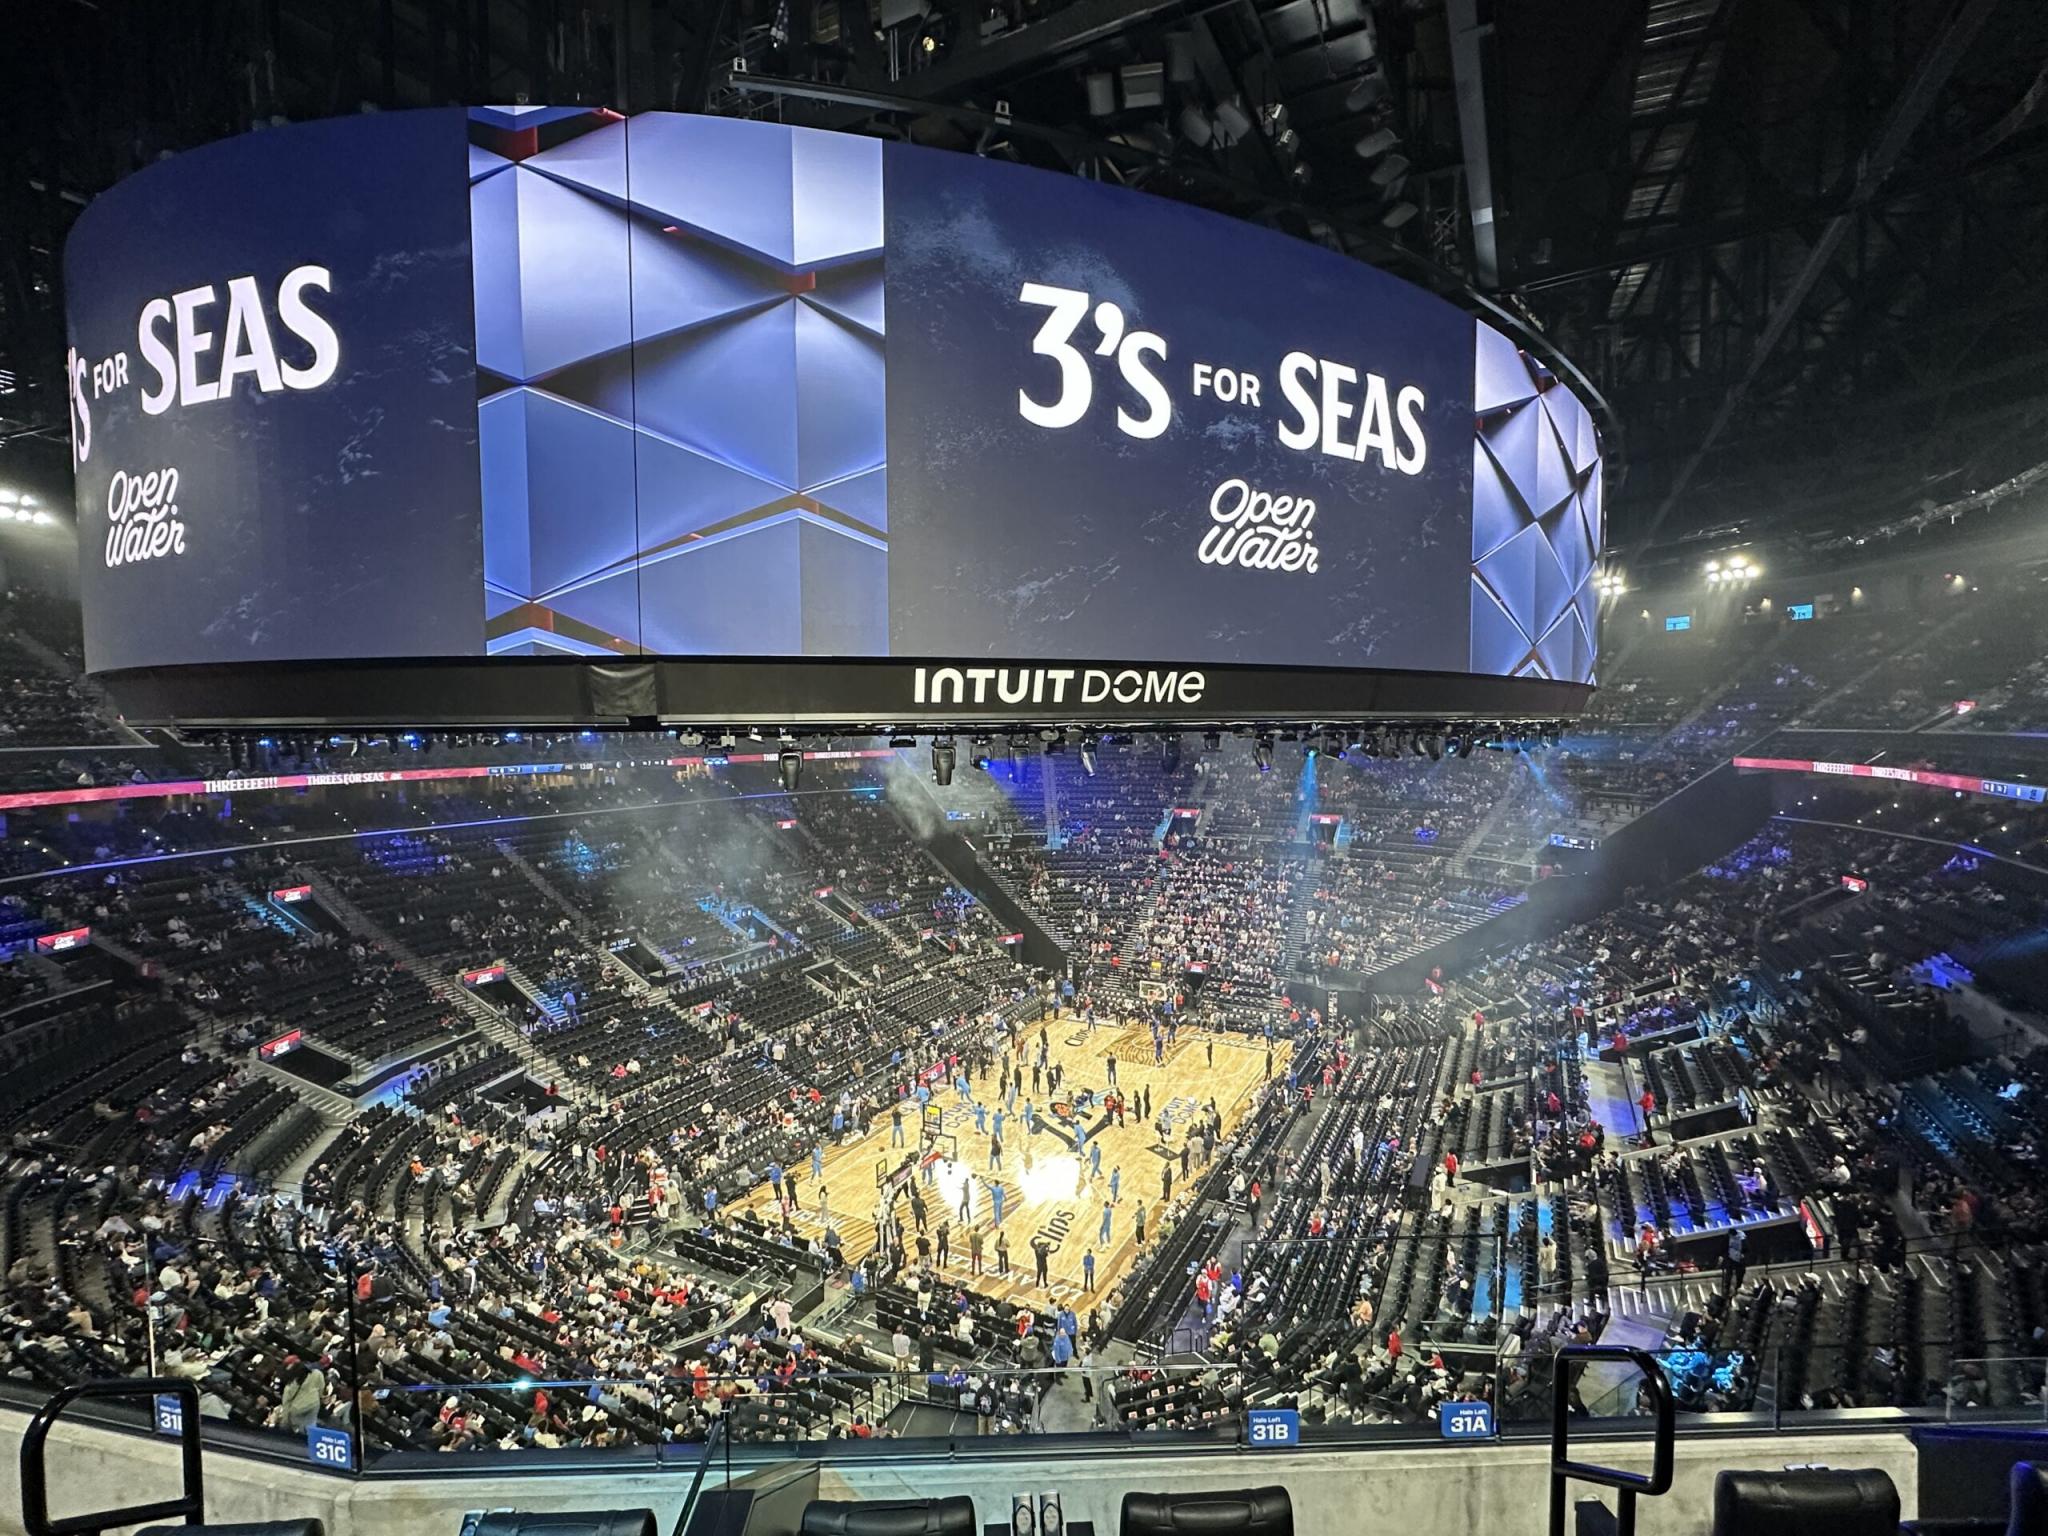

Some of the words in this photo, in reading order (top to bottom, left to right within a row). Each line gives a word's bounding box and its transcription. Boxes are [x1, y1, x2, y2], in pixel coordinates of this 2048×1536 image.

[68, 347, 92, 474] 'S
[93, 351, 129, 399] FOR
[138, 265, 340, 416] SEAS
[1019, 282, 1172, 439] 3'S
[1193, 363, 1261, 408] FOR
[1278, 351, 1427, 476] SEAS
[107, 467, 179, 524] Open
[1209, 478, 1316, 530] Open
[105, 504, 186, 568] Water
[1198, 525, 1319, 574] Water
[914, 667, 1075, 704] INTUIT
[1081, 669, 1206, 704] DOME
[1252, 1422, 1289, 1441] 31B
[1450, 1415, 1488, 1433] 31A
[315, 1441, 347, 1463] 31C
